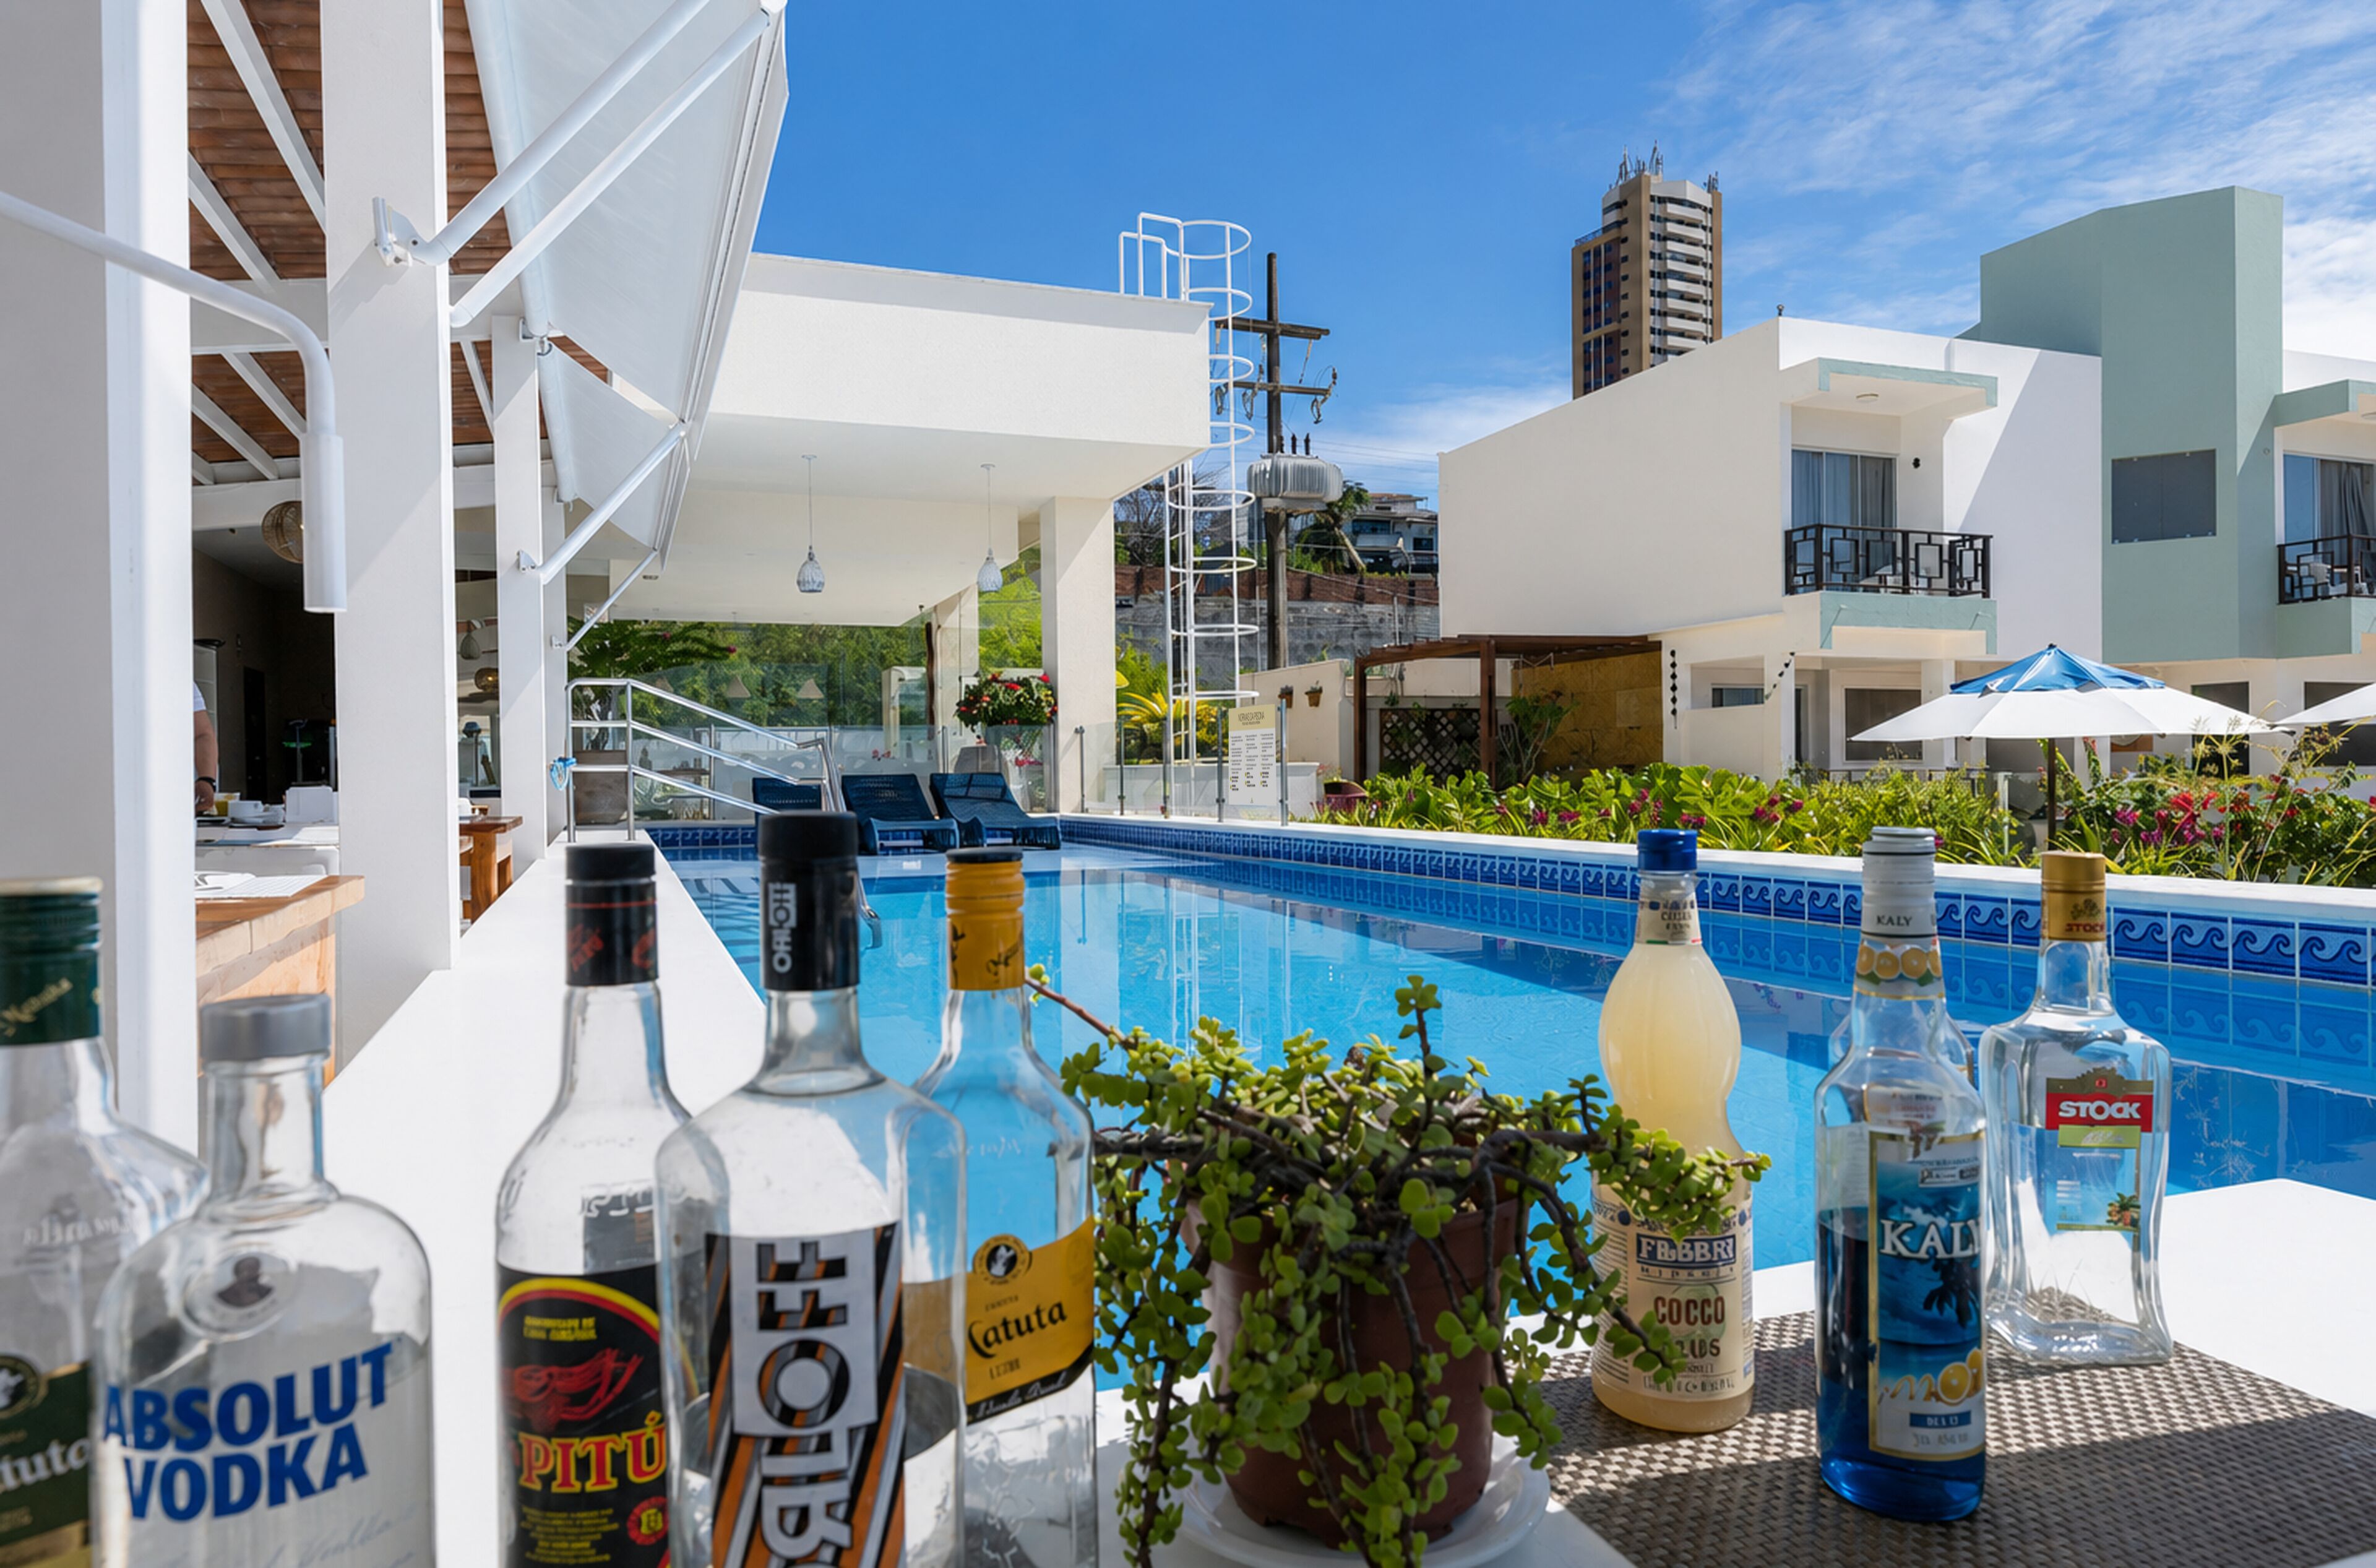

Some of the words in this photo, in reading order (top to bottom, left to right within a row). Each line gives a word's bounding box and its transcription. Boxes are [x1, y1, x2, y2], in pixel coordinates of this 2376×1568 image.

[1877, 916, 1913, 927] KALY
[2059, 1100, 2141, 1121] STOCK
[1654, 1296, 1725, 1326] COCCO
[103, 1342, 394, 1453] ABSOLUT
[755, 1240, 853, 1568] RLOFF
[124, 1422, 369, 1525] VODKA
[519, 1410, 668, 1493] PITÚ
